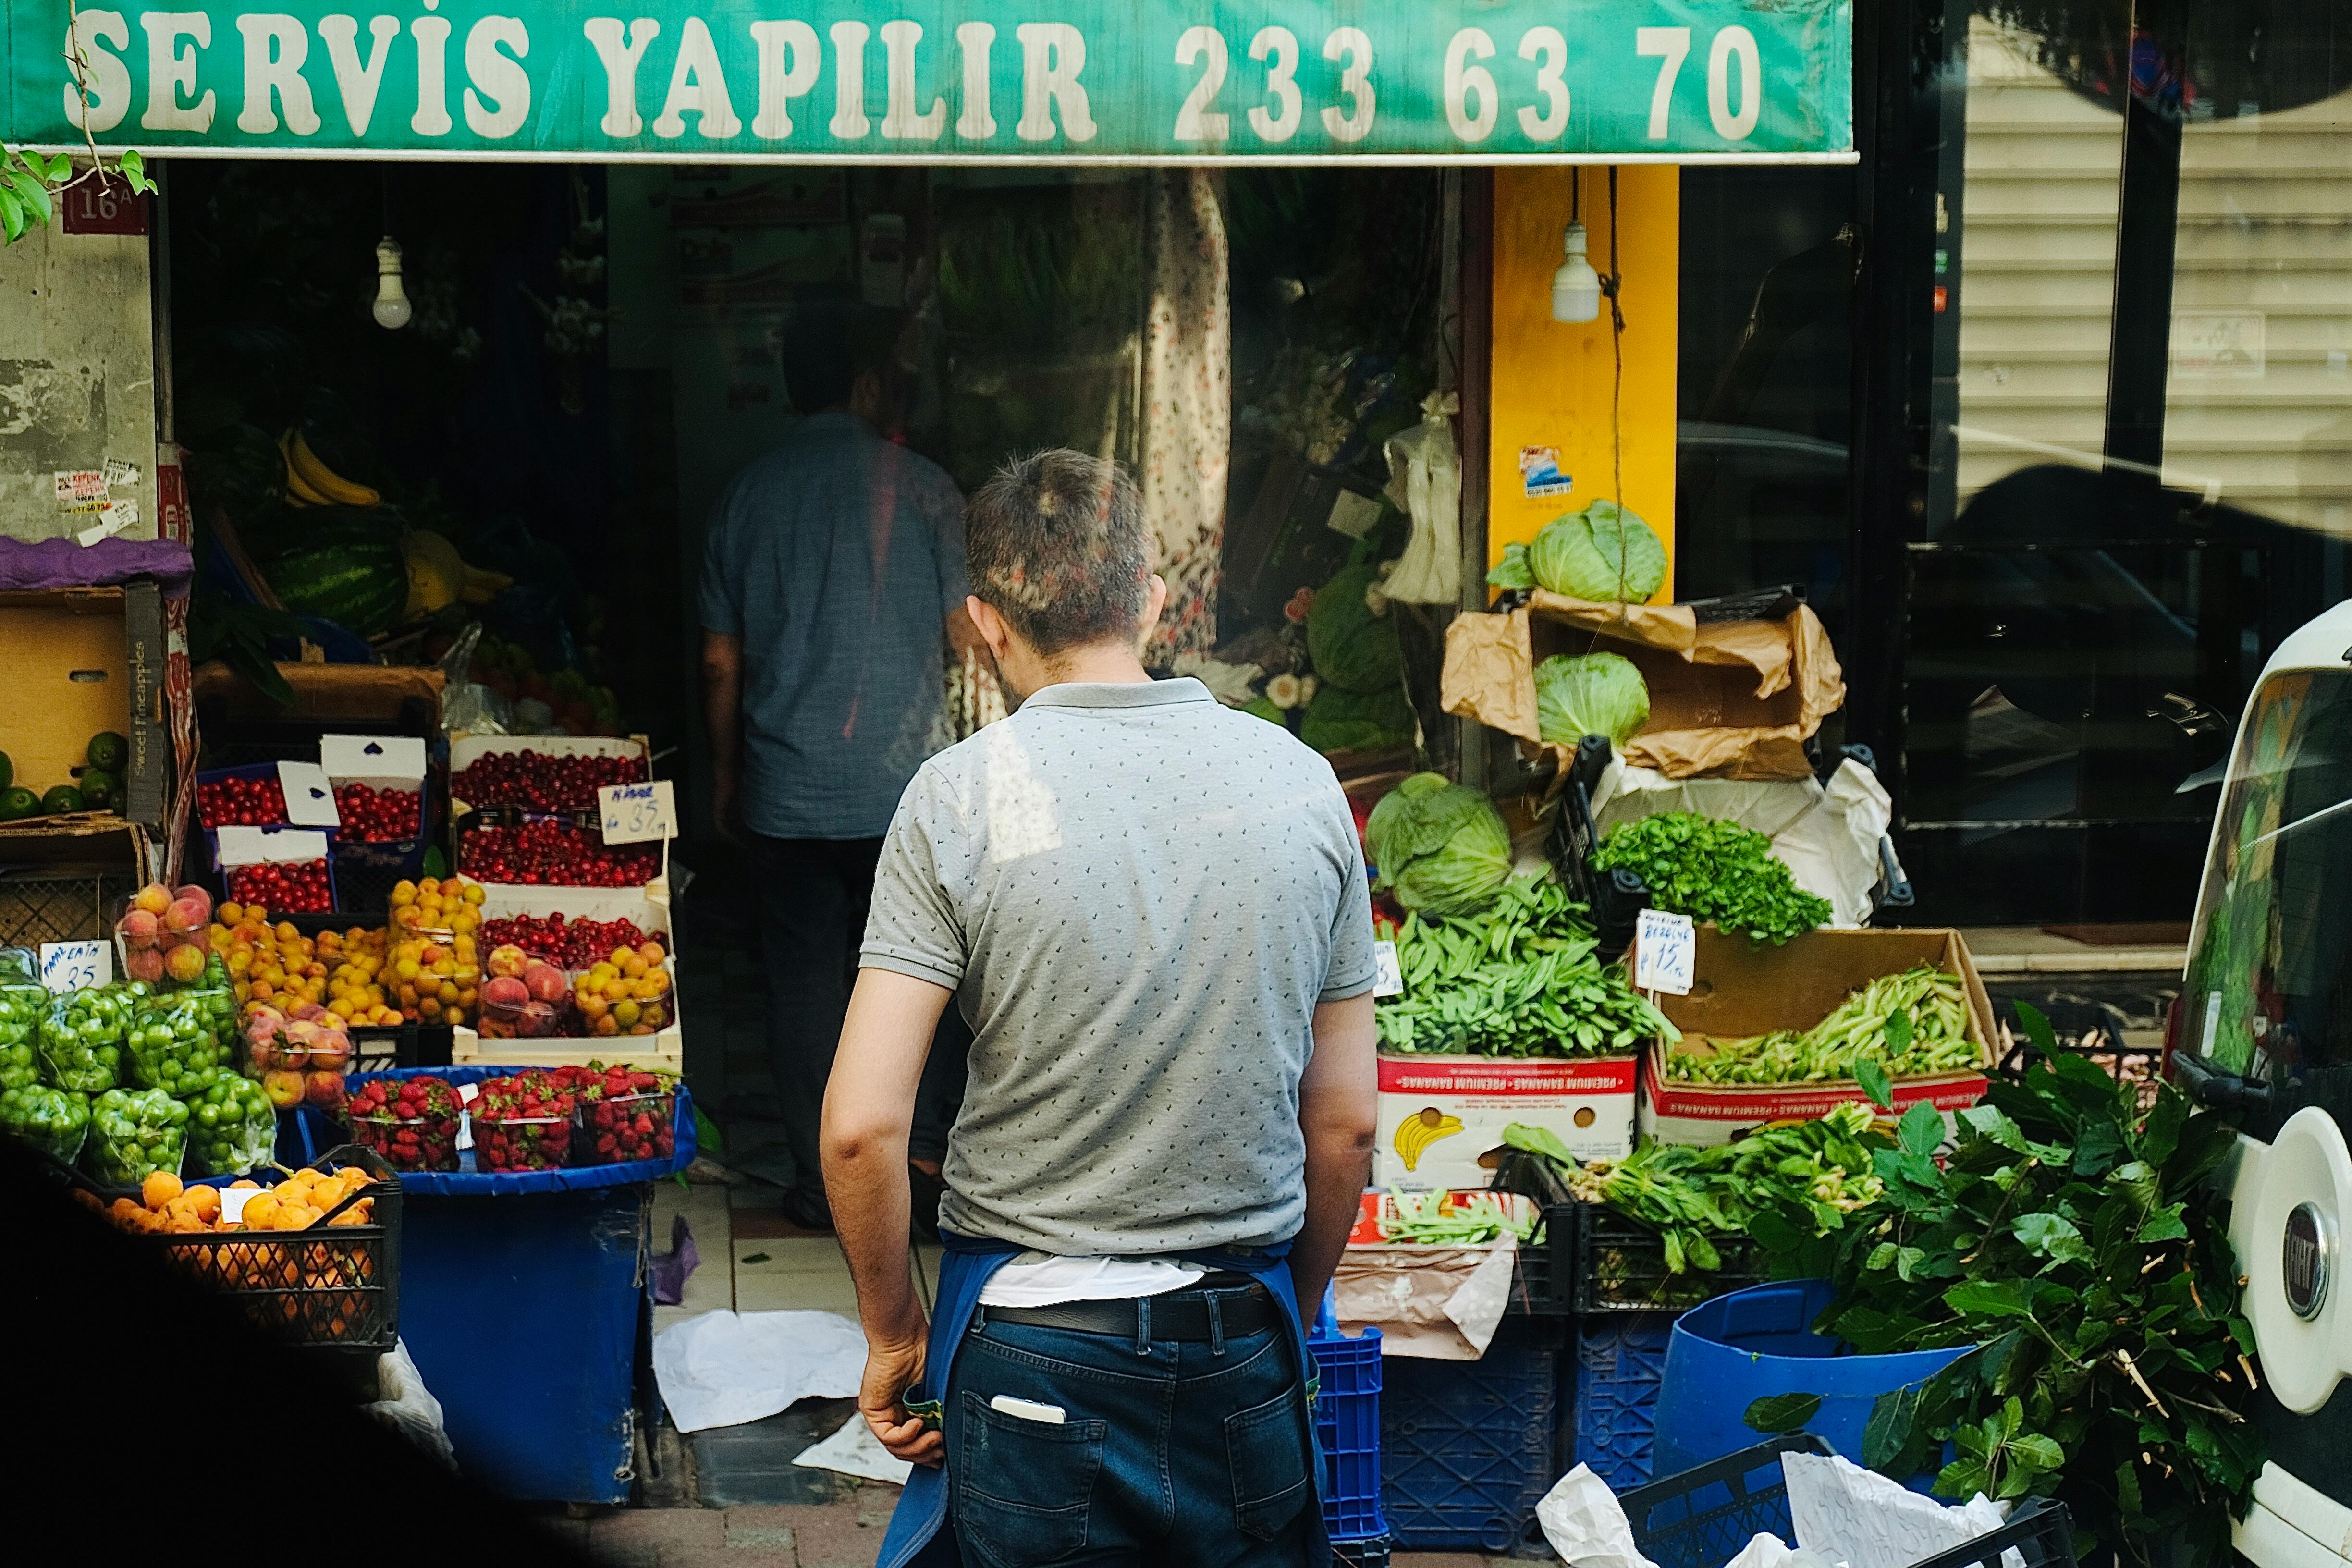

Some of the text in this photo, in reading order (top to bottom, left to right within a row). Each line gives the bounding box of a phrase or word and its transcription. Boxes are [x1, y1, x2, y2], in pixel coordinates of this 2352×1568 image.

[64, 0, 1762, 143] SERVİS YAPILIR 233 63 70
